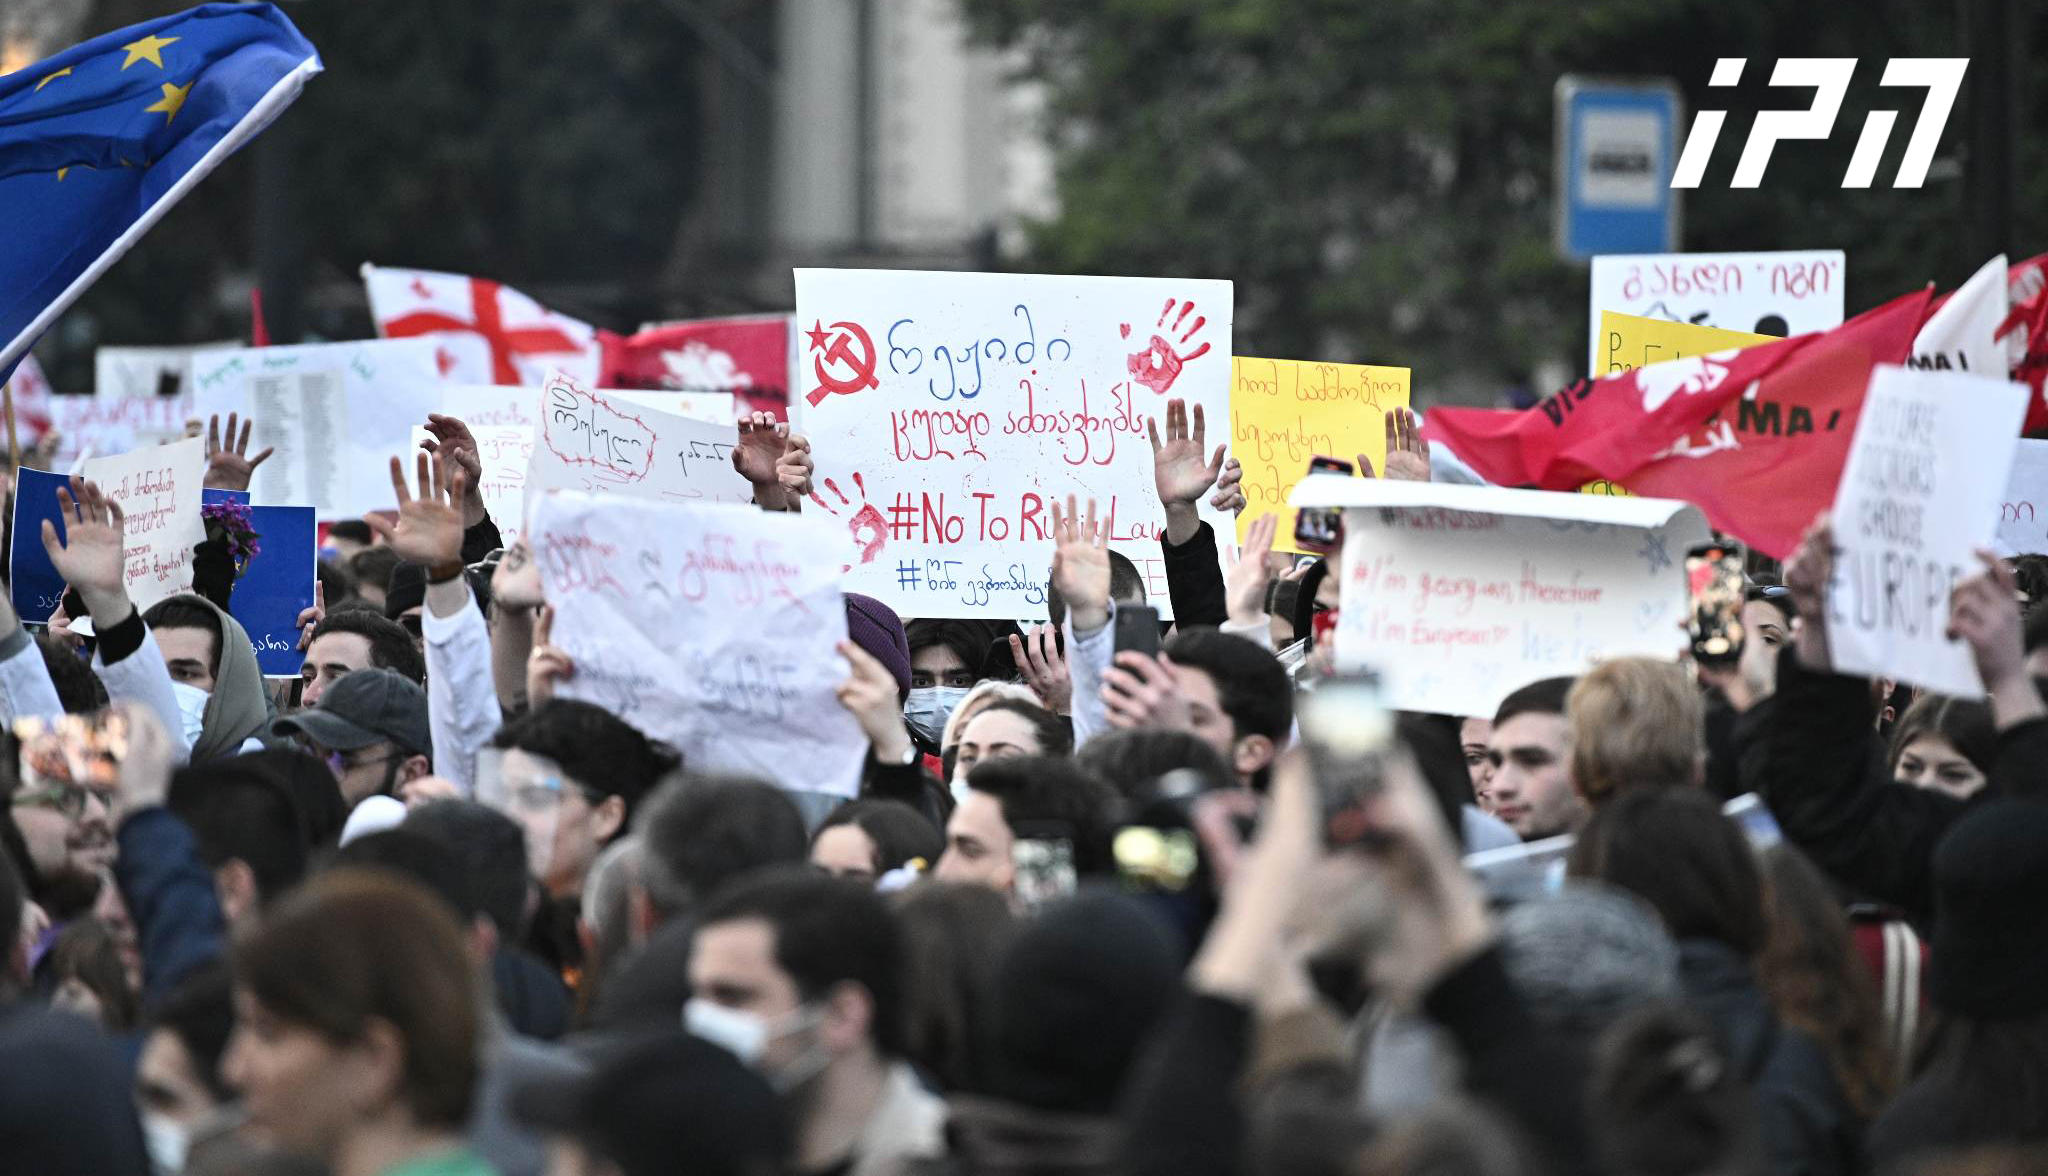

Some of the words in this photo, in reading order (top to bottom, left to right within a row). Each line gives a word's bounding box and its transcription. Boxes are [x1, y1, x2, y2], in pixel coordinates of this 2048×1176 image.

[887, 303, 1071, 401] რეჟიმი
[890, 409, 990, 462] ცუდად
[1003, 378, 1143, 466] ამთავრებს
[887, 491, 965, 544] #No
[971, 491, 1009, 542] To
[962, 562, 1053, 607] ევროპისკ
